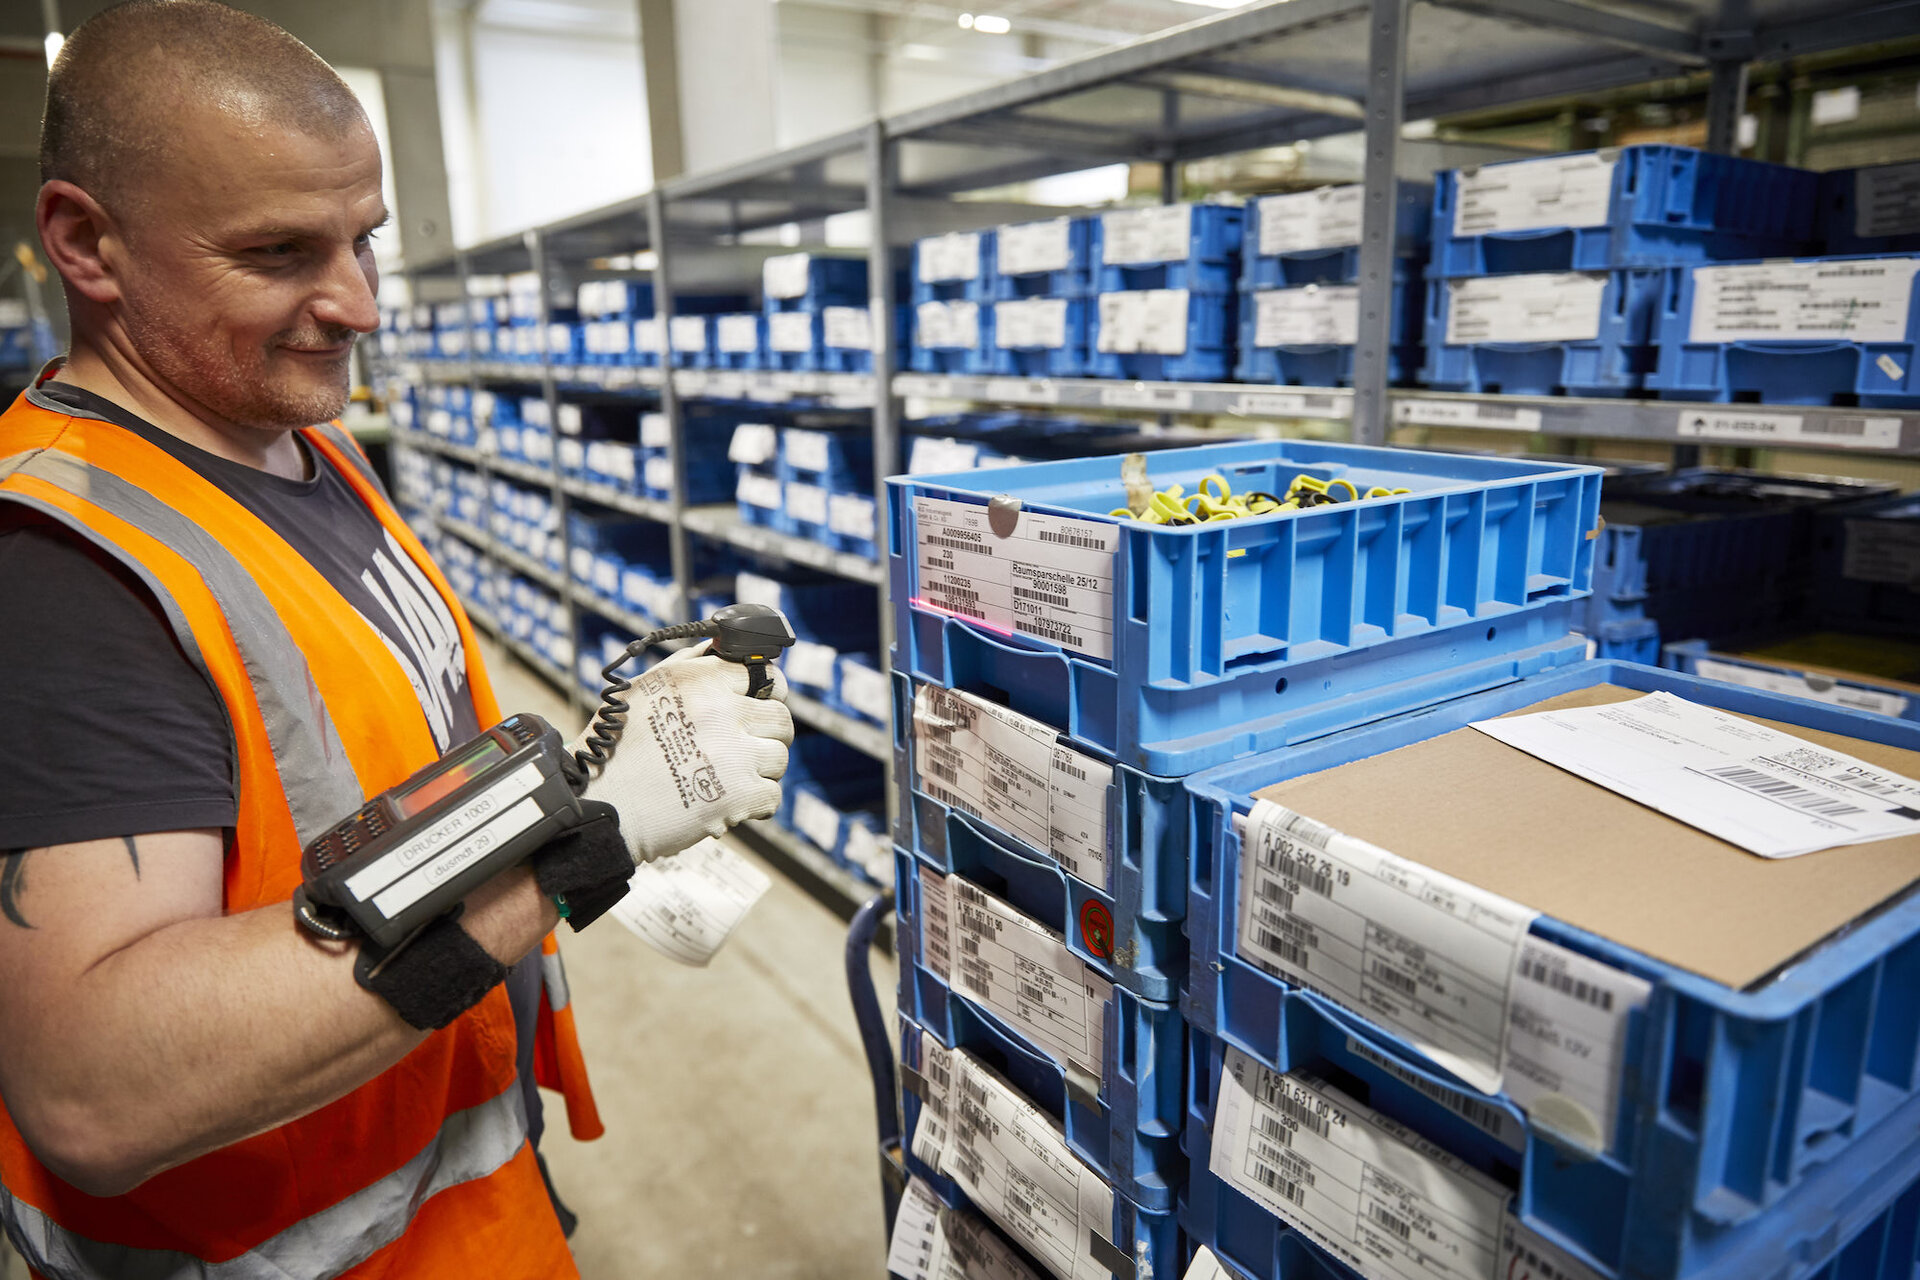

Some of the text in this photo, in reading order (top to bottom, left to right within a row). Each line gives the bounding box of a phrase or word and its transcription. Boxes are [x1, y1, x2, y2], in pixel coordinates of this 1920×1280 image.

[942, 549, 953, 560] 230
[1012, 563, 1075, 585] Raumsparschelle
[1076, 575, 1098, 590] 25/12
[1033, 579, 1067, 595] 90001598
[1013, 600, 1042, 616] D171011
[1034, 617, 1072, 635] 107973722
[1845, 765, 1891, 783] DEU
[402, 799, 492, 861] DRUCKER 1003
[474, 834, 491, 850] 29
[1263, 831, 1271, 847] A
[1274, 836, 1294, 858] 002
[1296, 848, 1317, 870] 542
[1336, 868, 1351, 887] 19
[1262, 1070, 1347, 1128] A 901 631 00 24
[1280, 1113, 1299, 1133] 300
